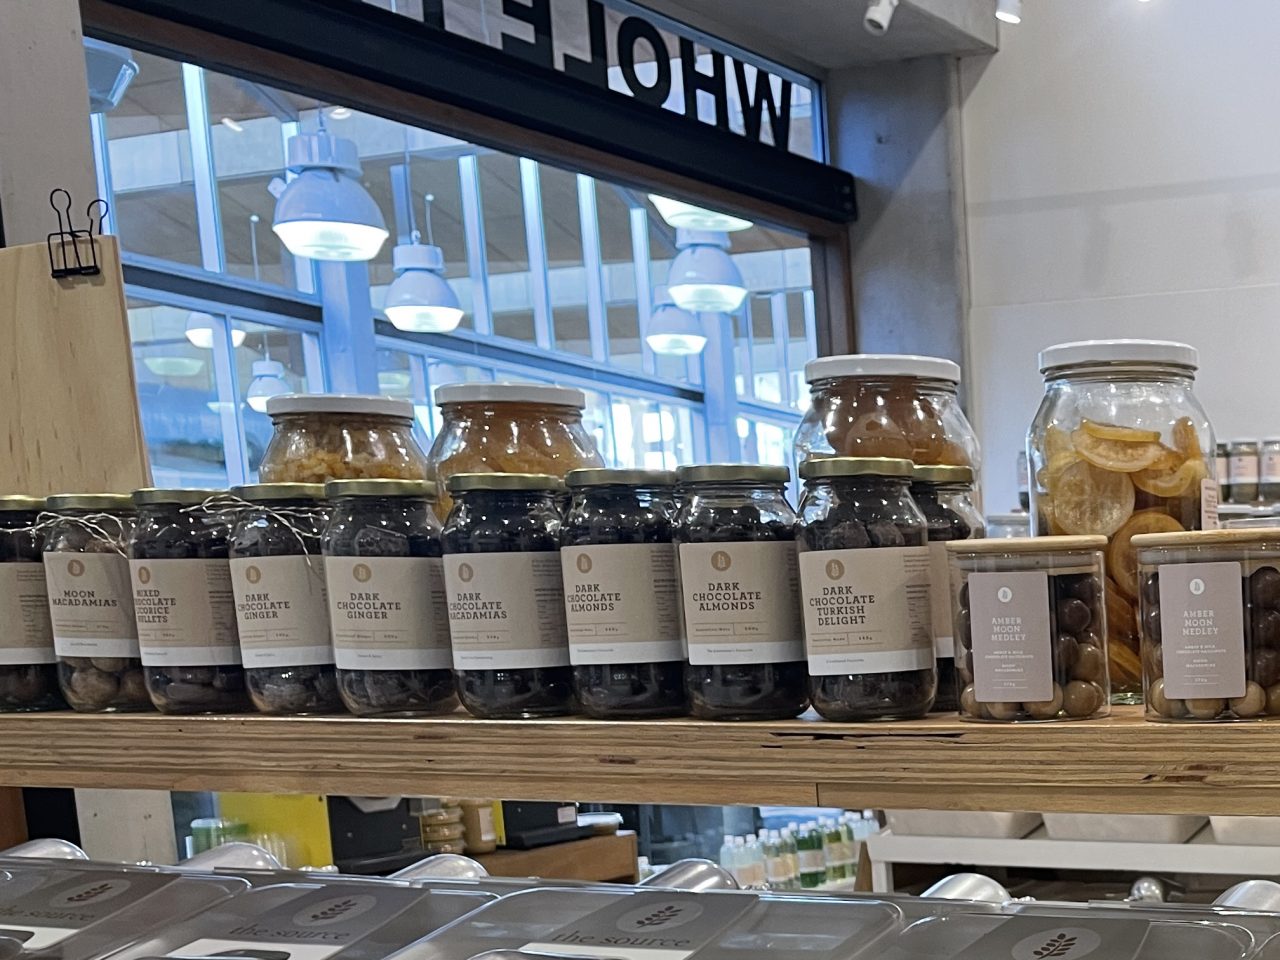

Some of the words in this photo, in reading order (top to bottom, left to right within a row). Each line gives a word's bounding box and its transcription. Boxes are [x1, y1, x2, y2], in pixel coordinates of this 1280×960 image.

[575, 584, 600, 593] DARK
[708, 582, 740, 591] DARK
[823, 586, 853, 596] DARK
[64, 590, 95, 598] MOON
[245, 593, 270, 601] DARK
[350, 593, 380, 601] DARK
[457, 593, 482, 601] DARK
[567, 593, 621, 603] CHOCOLATE
[692, 591, 762, 601] CHOCOLATE
[52, 598, 117, 607] MACADAMIAS
[809, 595, 875, 606] CHOCOLATE
[237, 602, 290, 611] CHOCOLATE
[337, 602, 401, 611] CHOCOLATE
[449, 602, 502, 611] CHOCOLATE
[571, 603, 615, 613] ALMONDS
[699, 602, 755, 611] ALMONDS
[817, 605, 865, 616] TURKISH
[244, 611, 279, 620] GINGER
[347, 611, 388, 620] GINGER
[1183, 610, 1214, 618] AMBER
[818, 616, 866, 626] DELIGHT
[991, 617, 1022, 625] AMBER
[1184, 618, 1213, 627] MOON
[993, 625, 1020, 633] MOON
[1182, 627, 1218, 635] MEDLEY
[551, 930, 595, 944] the
[600, 935, 691, 947] source
